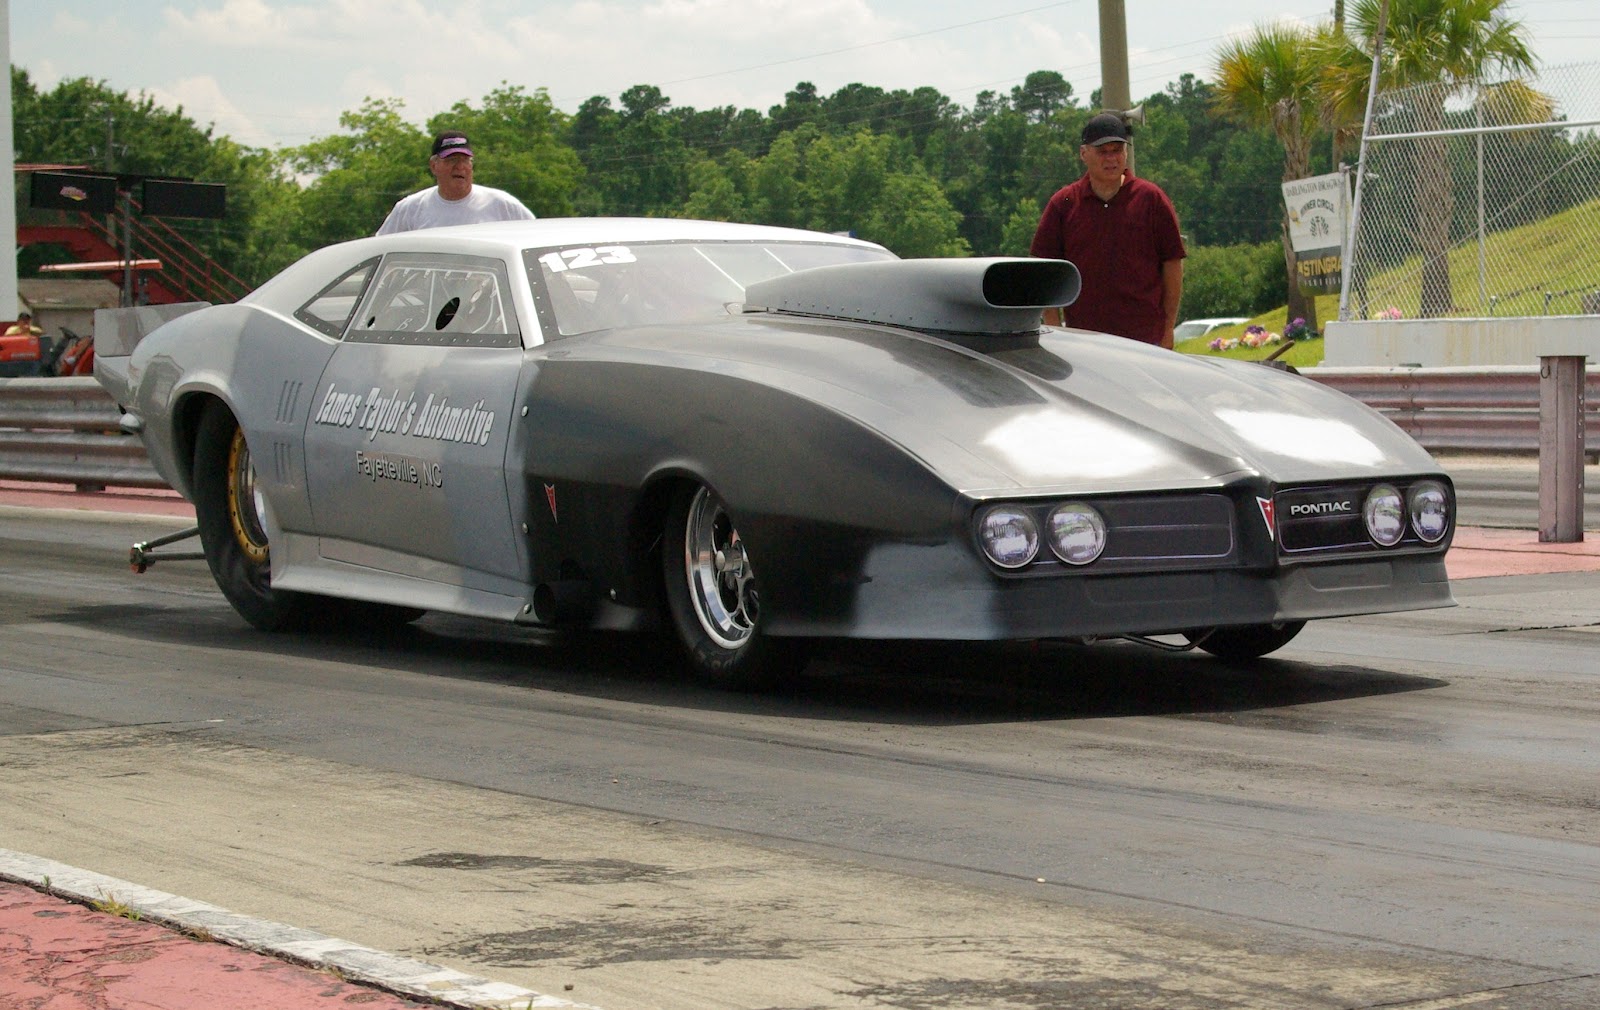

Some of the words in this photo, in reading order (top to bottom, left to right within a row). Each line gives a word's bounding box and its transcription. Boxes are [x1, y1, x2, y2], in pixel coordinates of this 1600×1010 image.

[1317, 198, 1335, 213] CIRCLE
[538, 246, 637, 273] 123
[315, 383, 362, 427] James
[359, 387, 417, 441] Taylor's
[413, 393, 495, 446] Automotive
[356, 450, 422, 489] Fayetteville,
[423, 462, 443, 488] NC
[1290, 501, 1351, 515] PONTIAC
